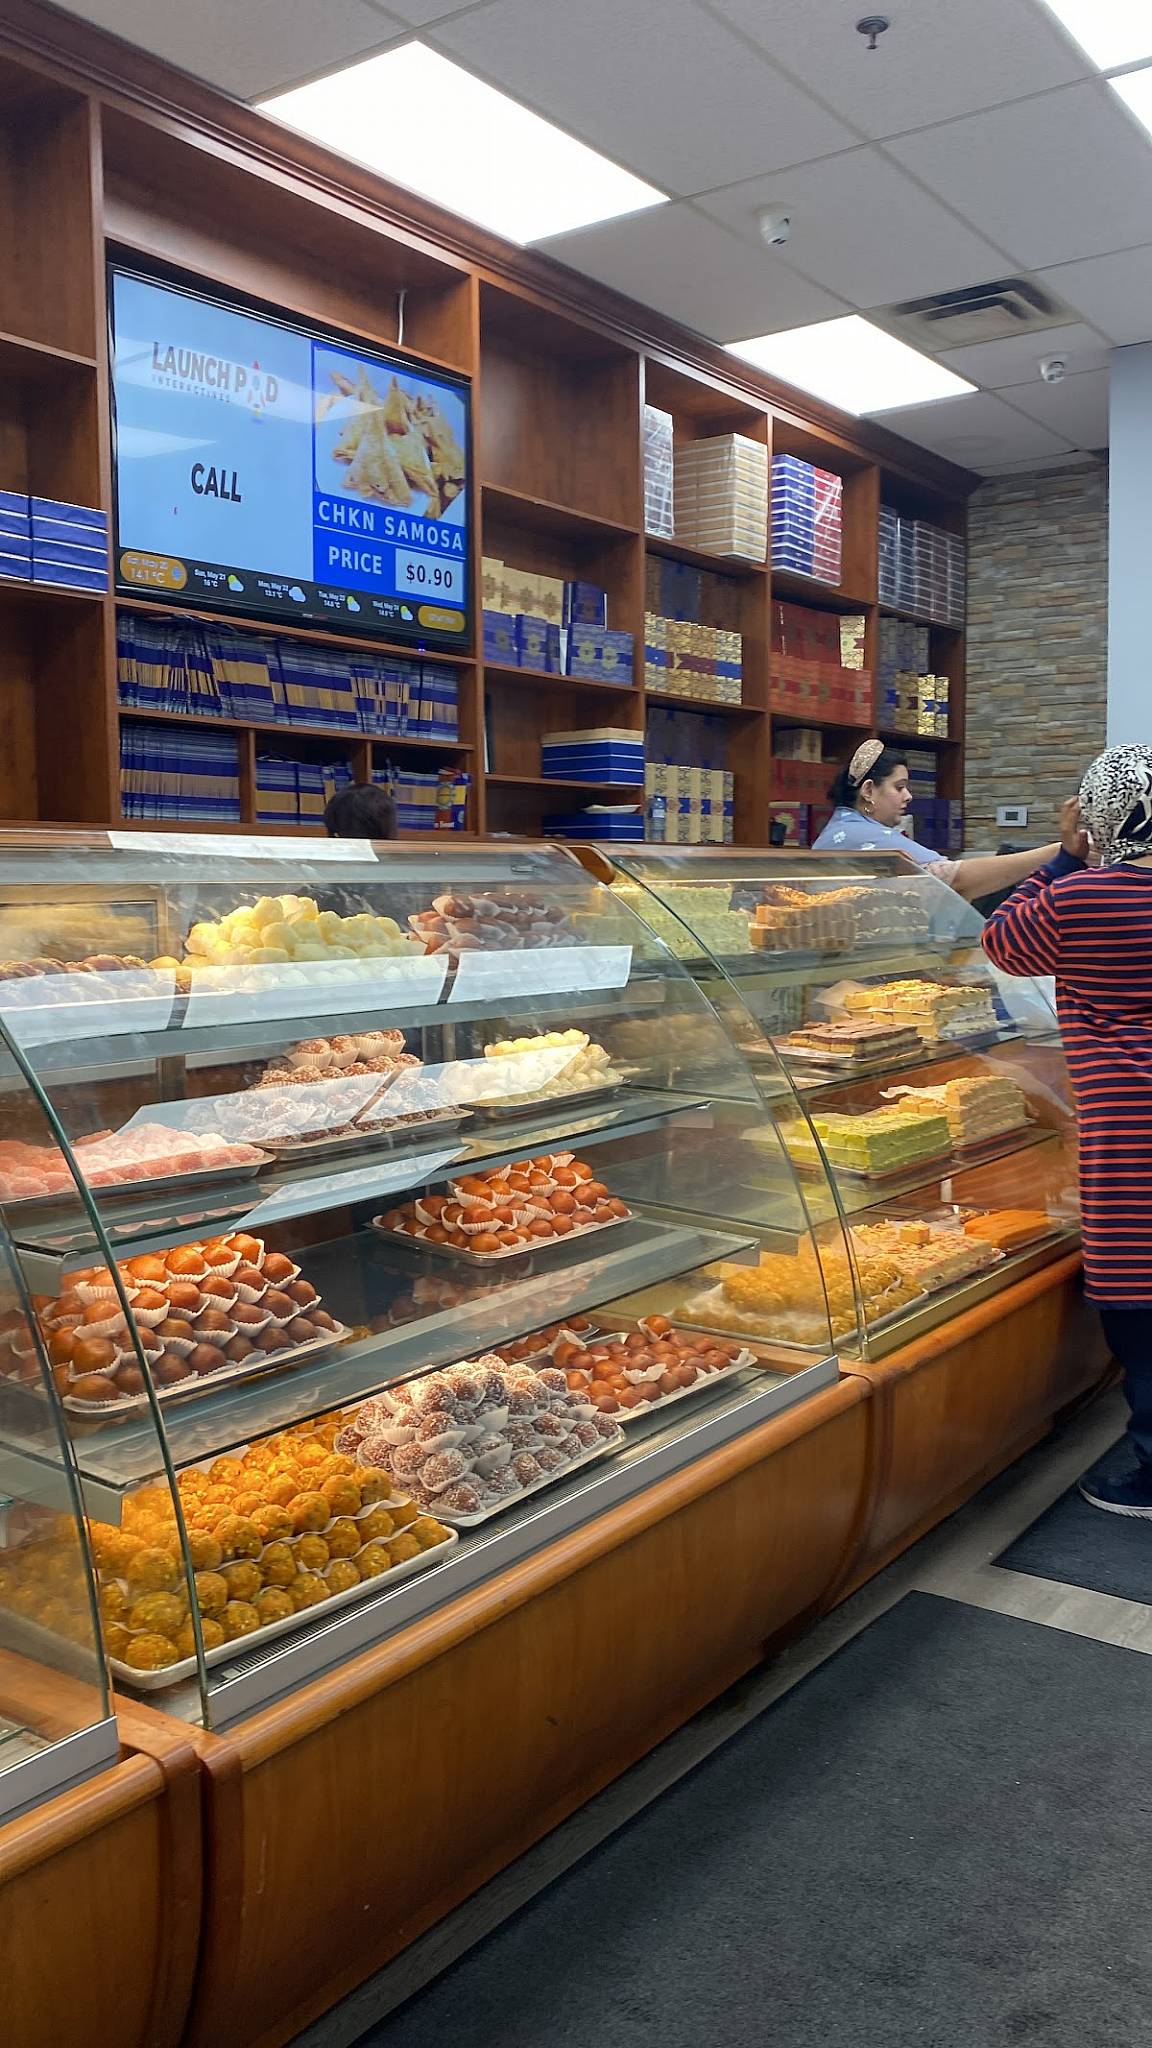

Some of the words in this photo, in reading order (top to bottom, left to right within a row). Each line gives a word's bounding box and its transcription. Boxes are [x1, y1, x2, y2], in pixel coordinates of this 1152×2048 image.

[152, 341, 231, 390] LAUNCH
[191, 462, 242, 503] CALL
[318, 500, 375, 531] CHKN
[384, 516, 463, 551] SAMOSA
[207, 570, 219, 580] May
[328, 545, 383, 575] PRICE
[406, 563, 453, 589] $0.90
[271, 582, 282, 592] May
[329, 592, 339, 601] May
[384, 601, 394, 610] May
